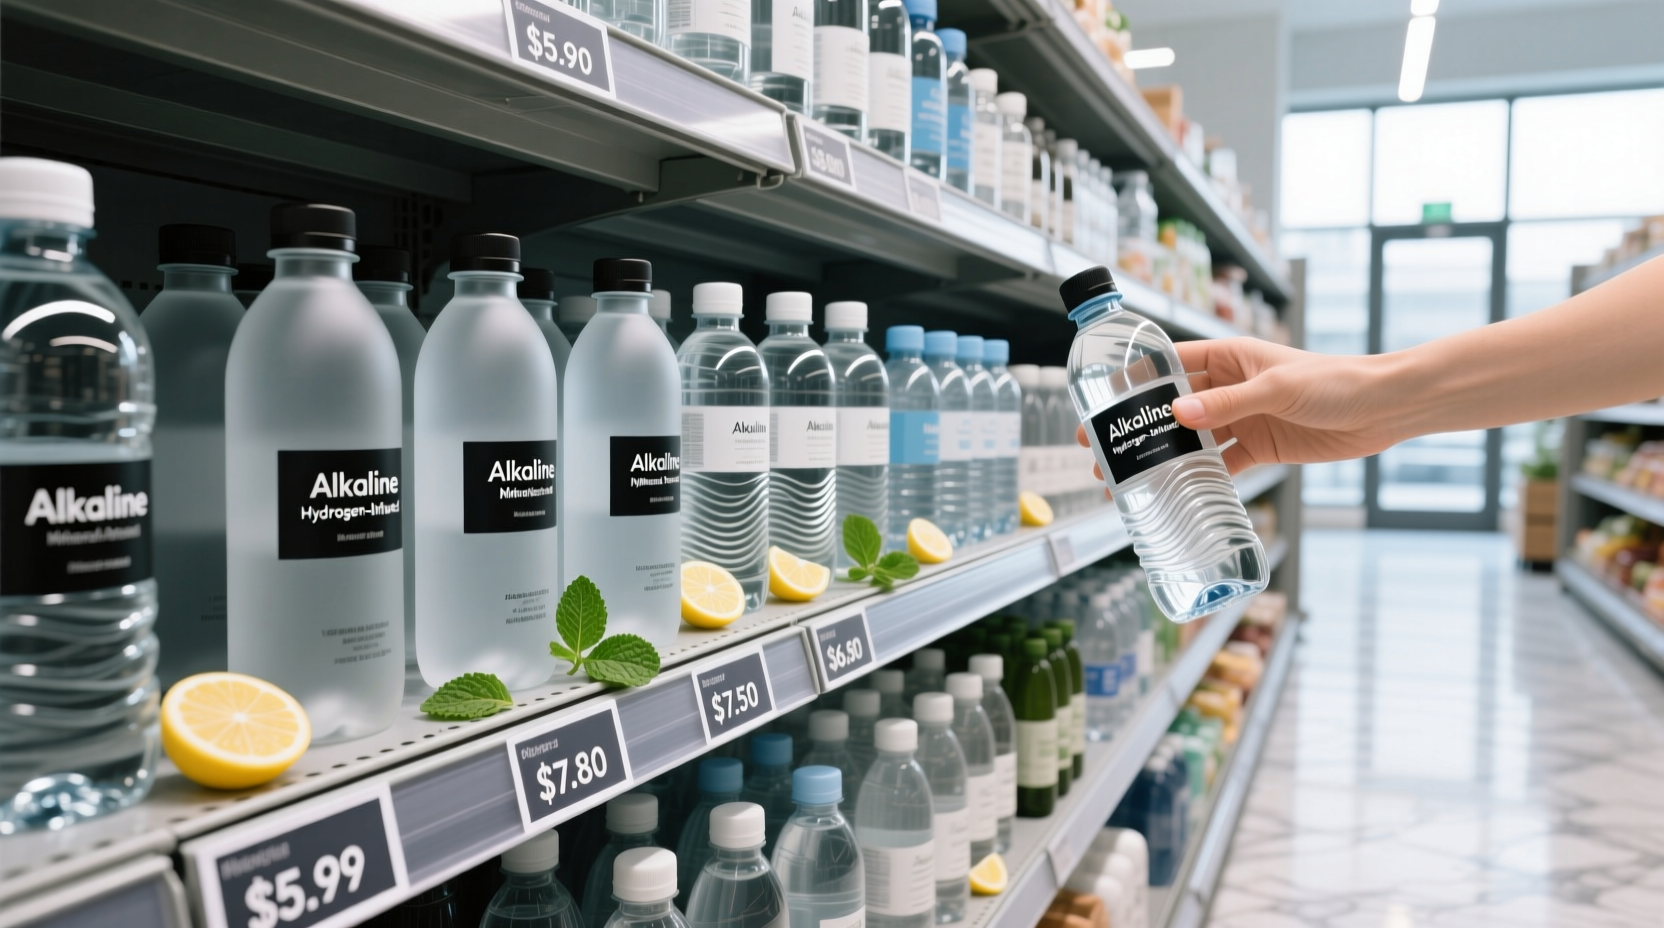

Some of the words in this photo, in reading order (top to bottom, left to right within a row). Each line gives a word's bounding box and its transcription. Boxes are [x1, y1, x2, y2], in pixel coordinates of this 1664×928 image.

[527, 22, 592, 75] $5.90
[1110, 404, 1173, 443] Alkaline
[309, 470, 399, 498] Alkaline
[487, 458, 555, 482] Alkaline
[24, 484, 148, 526] Alkaline
[711, 681, 759, 725] $7.50
[536, 746, 607, 805] $7.80
[244, 844, 365, 928] $5.99
